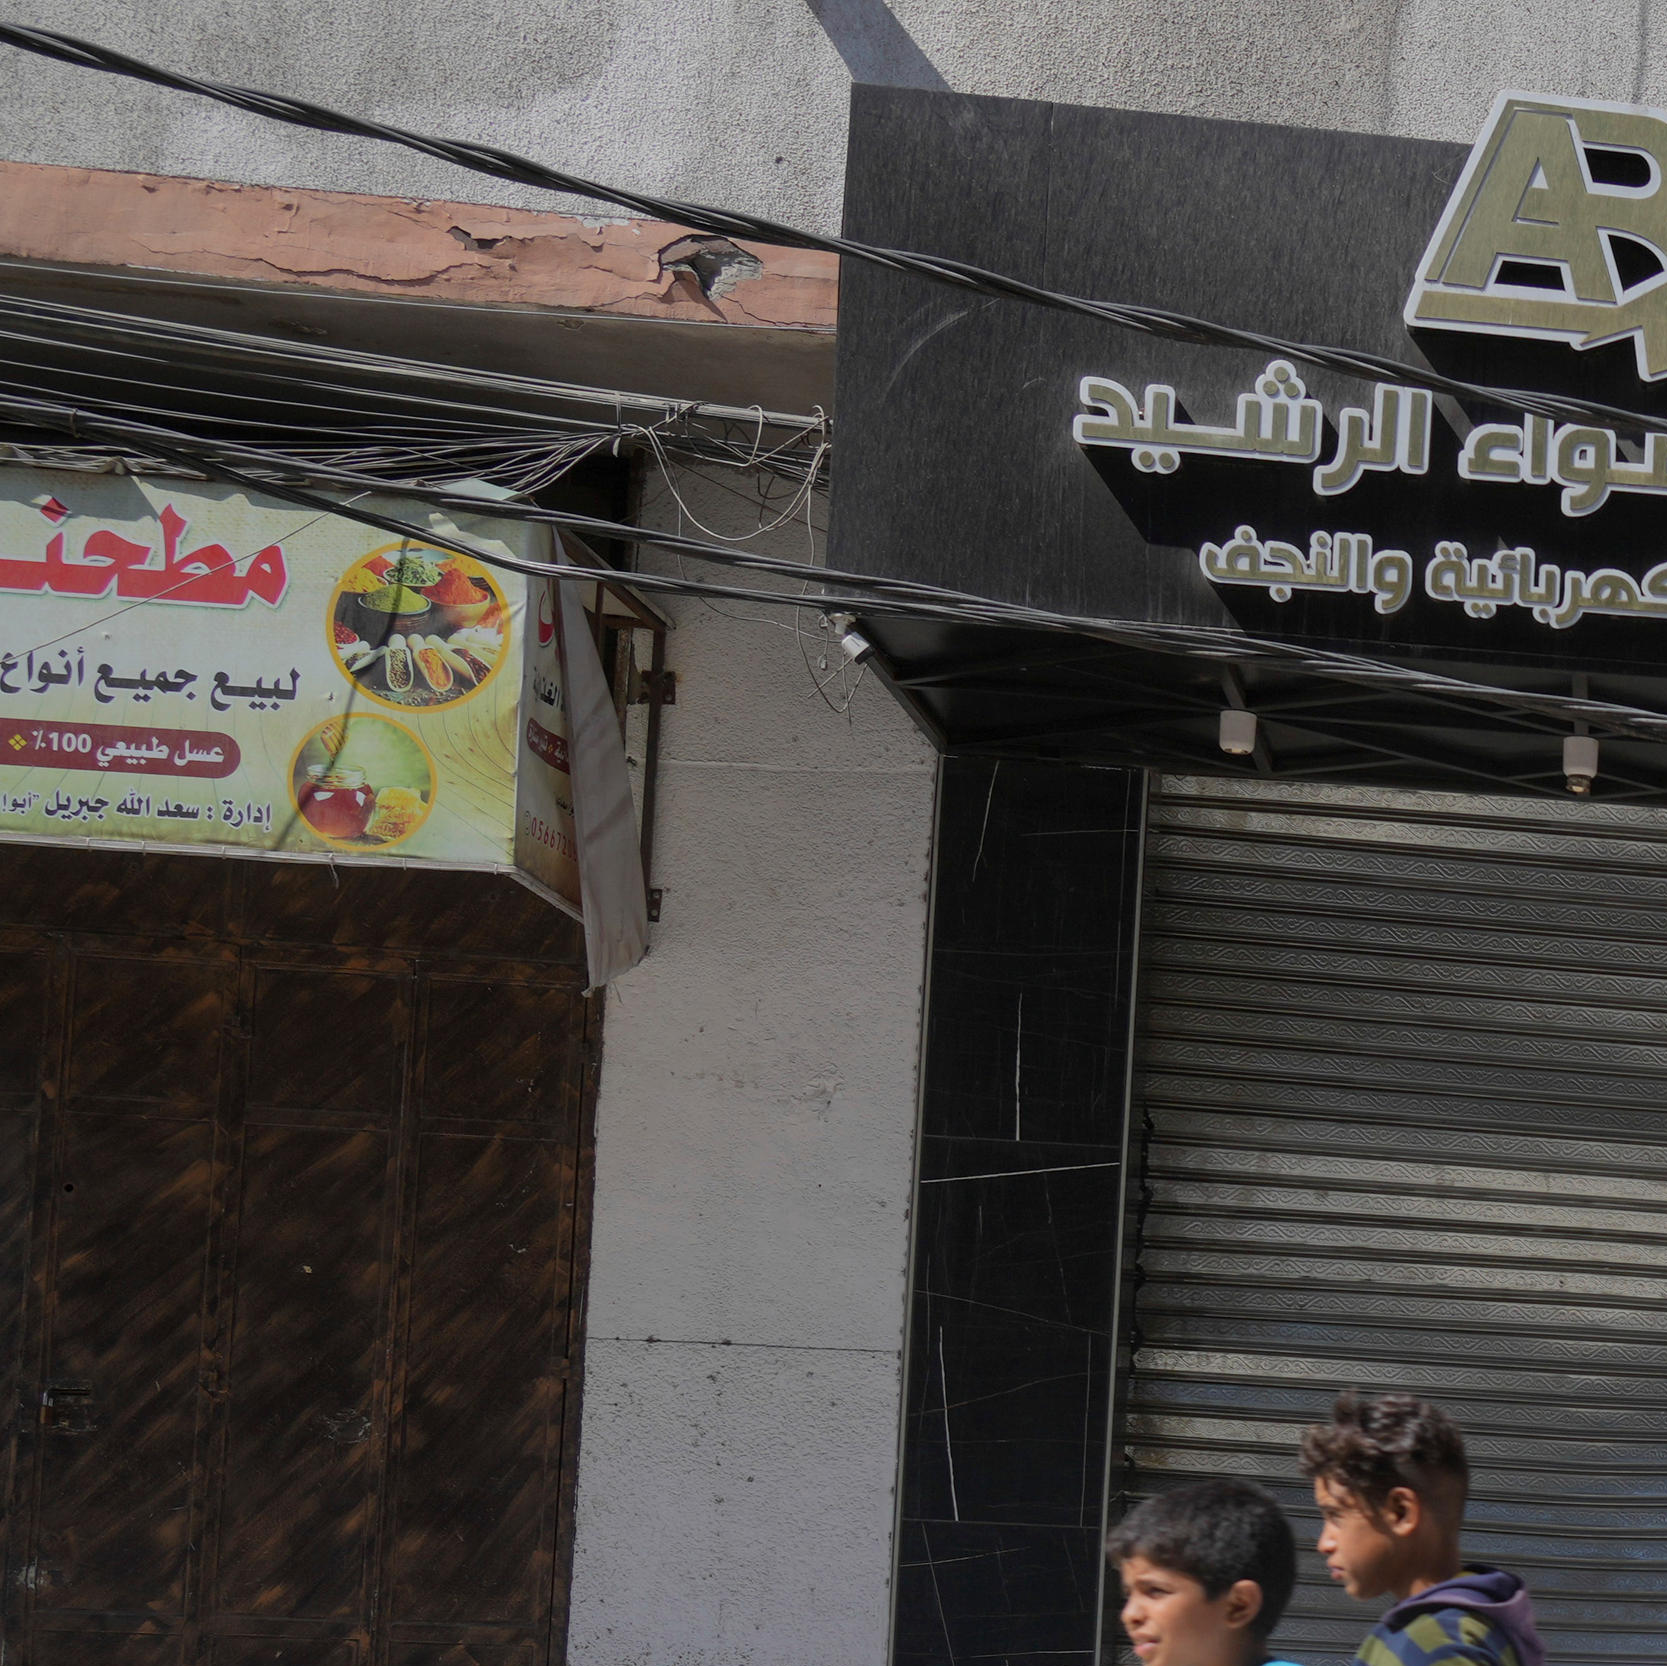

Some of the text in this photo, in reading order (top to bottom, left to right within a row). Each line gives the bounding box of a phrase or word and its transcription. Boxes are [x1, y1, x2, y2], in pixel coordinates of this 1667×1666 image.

[1073, 360, 1433, 495] الرشيد
[0, 497, 287, 606] مطحن
[1200, 525, 1412, 614] والنجف
[0, 646, 300, 711] لبيع جميع أنواع
[96, 736, 170, 766] طبيعي
[174, 739, 225, 766] عسل
[45, 790, 109, 821] جبريل
[116, 787, 151, 816] الله
[156, 800, 200, 820] سعد
[221, 800, 271, 832] إدارة
